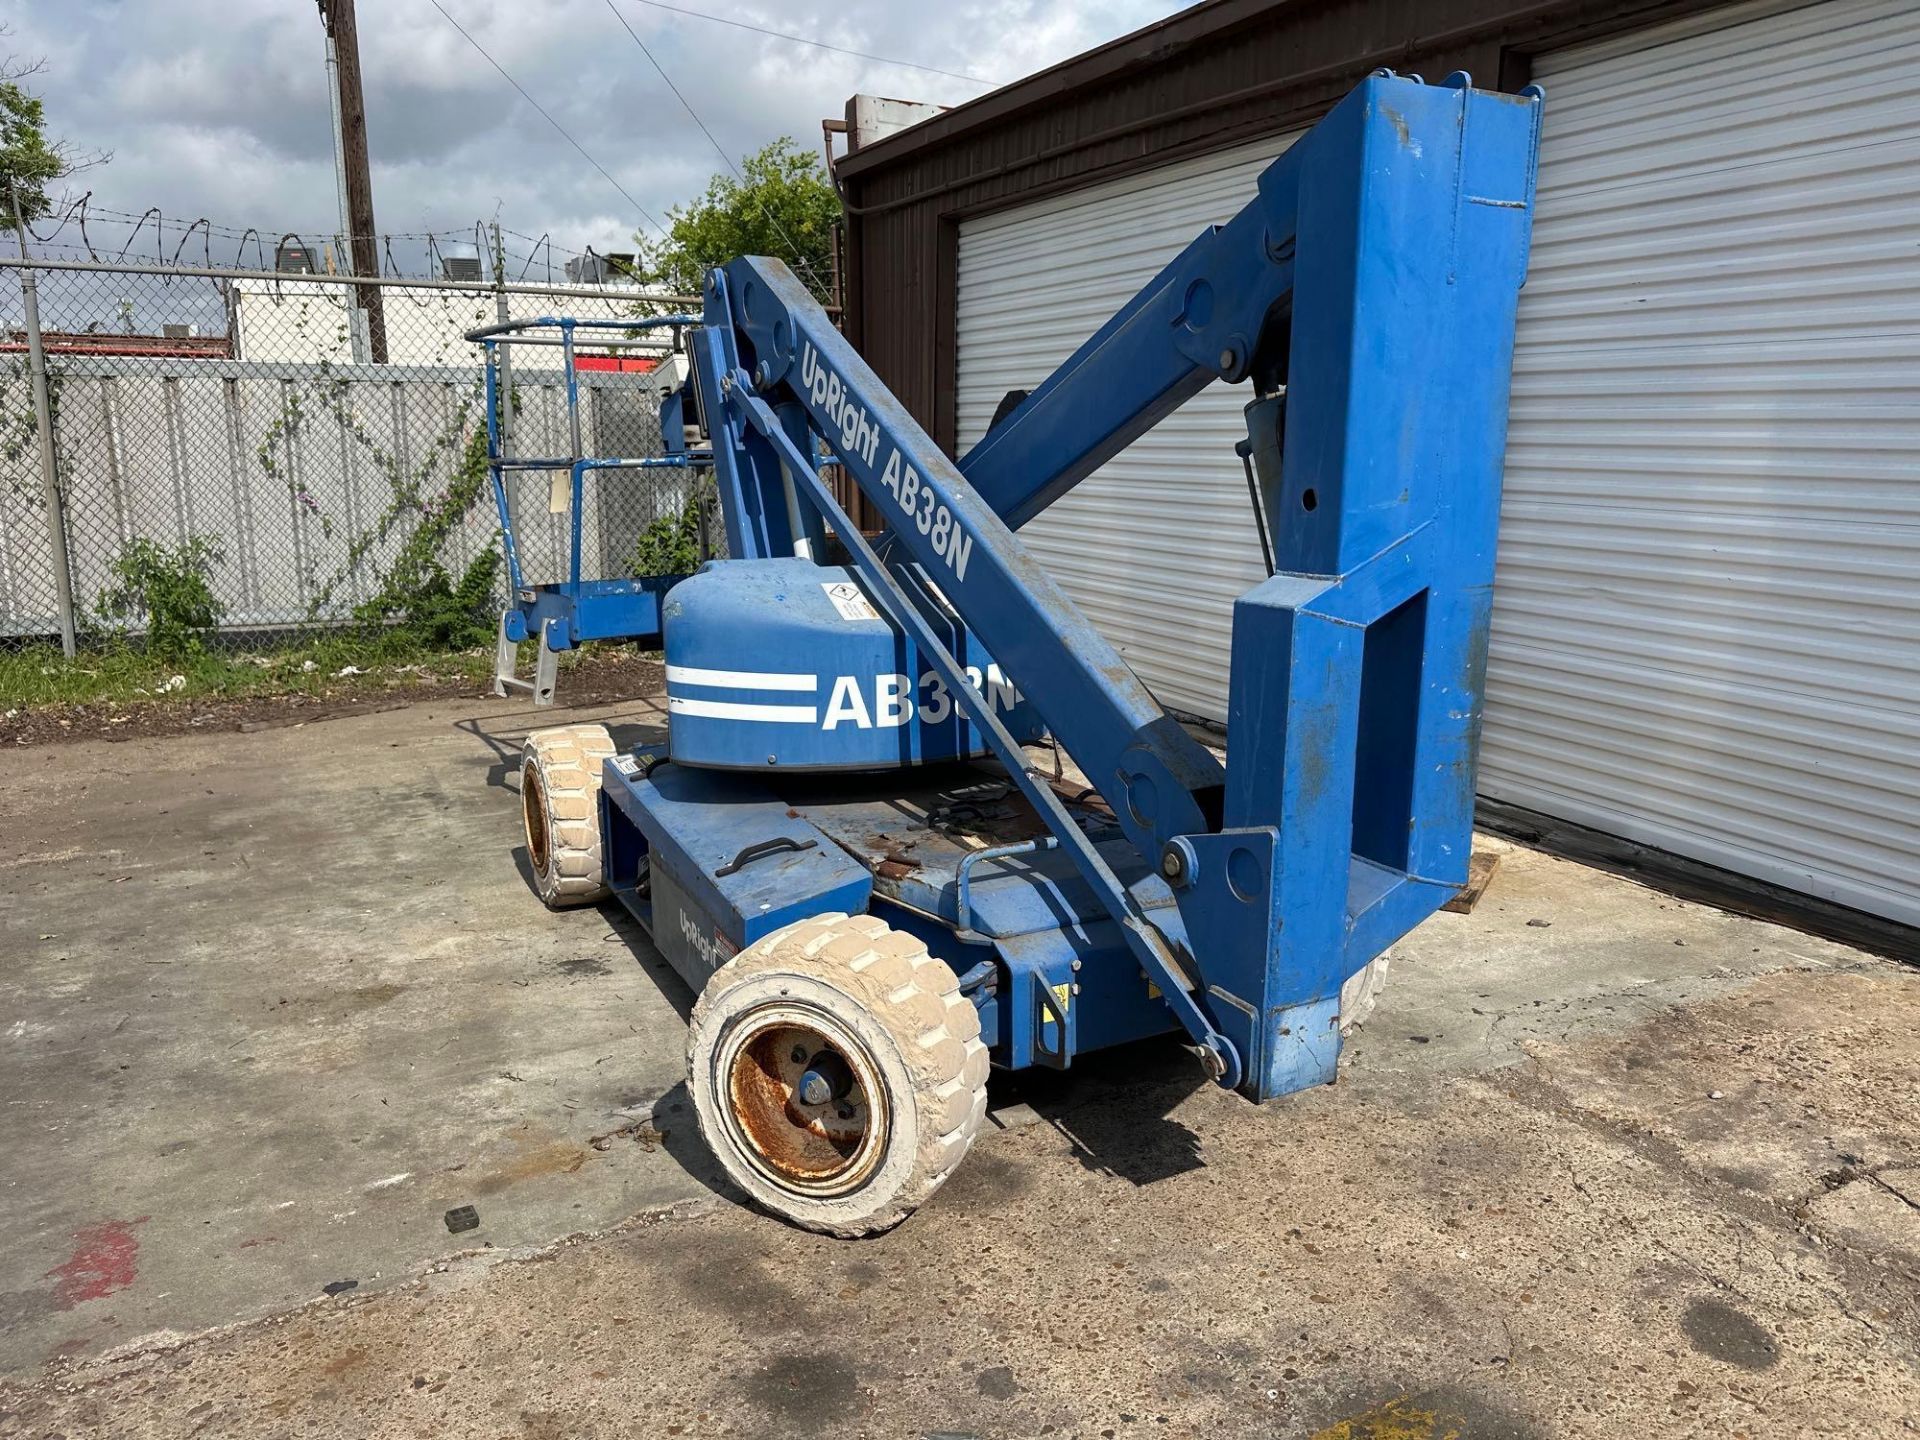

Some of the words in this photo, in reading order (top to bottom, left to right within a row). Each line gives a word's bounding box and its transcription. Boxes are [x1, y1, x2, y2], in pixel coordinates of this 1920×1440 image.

[802, 341, 880, 469] UpRight
[881, 448, 973, 583] AB38N
[680, 908, 717, 969] UpRight
